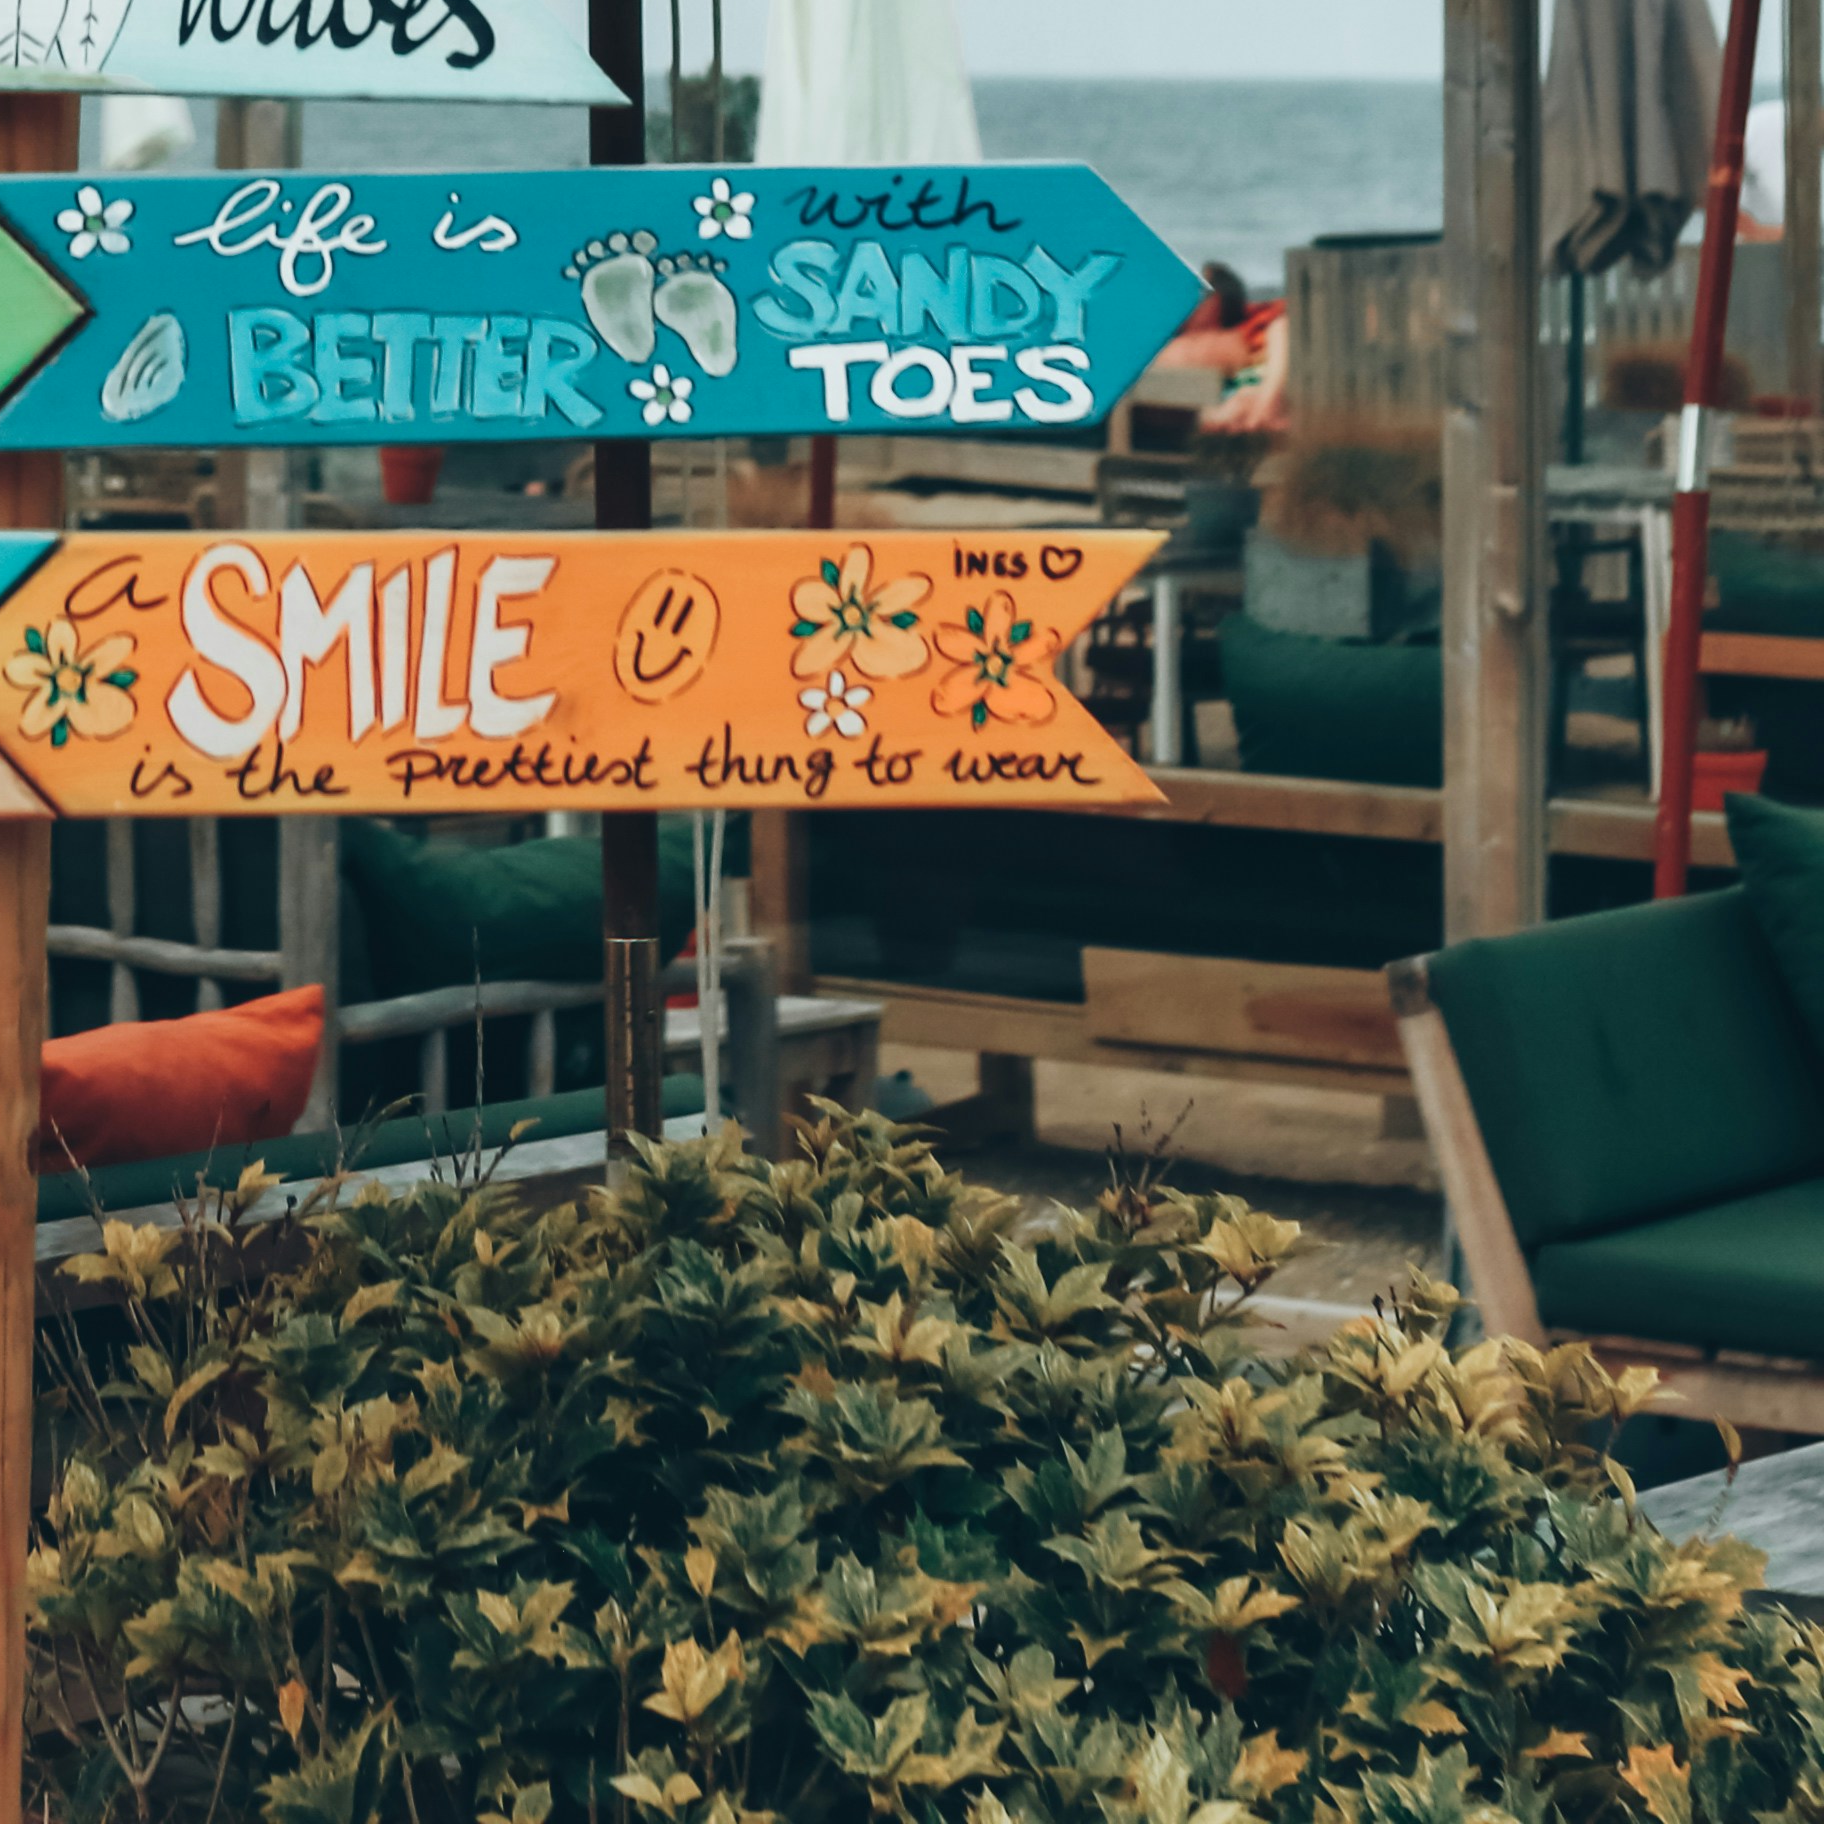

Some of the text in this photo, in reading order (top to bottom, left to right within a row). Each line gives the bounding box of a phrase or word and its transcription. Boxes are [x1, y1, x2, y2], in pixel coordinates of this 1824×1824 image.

[174, 178, 519, 298] life is
[788, 177, 1024, 236] with
[754, 237, 1124, 344] SANDY
[228, 304, 611, 430] BETTER
[788, 342, 1094, 426] TOES
[64, 540, 561, 758] a SMILE
[129, 744, 193, 798] is
[225, 745, 350, 800] the
[686, 724, 834, 800] thing
[852, 747, 918, 790] to
[944, 748, 1104, 788] wear
